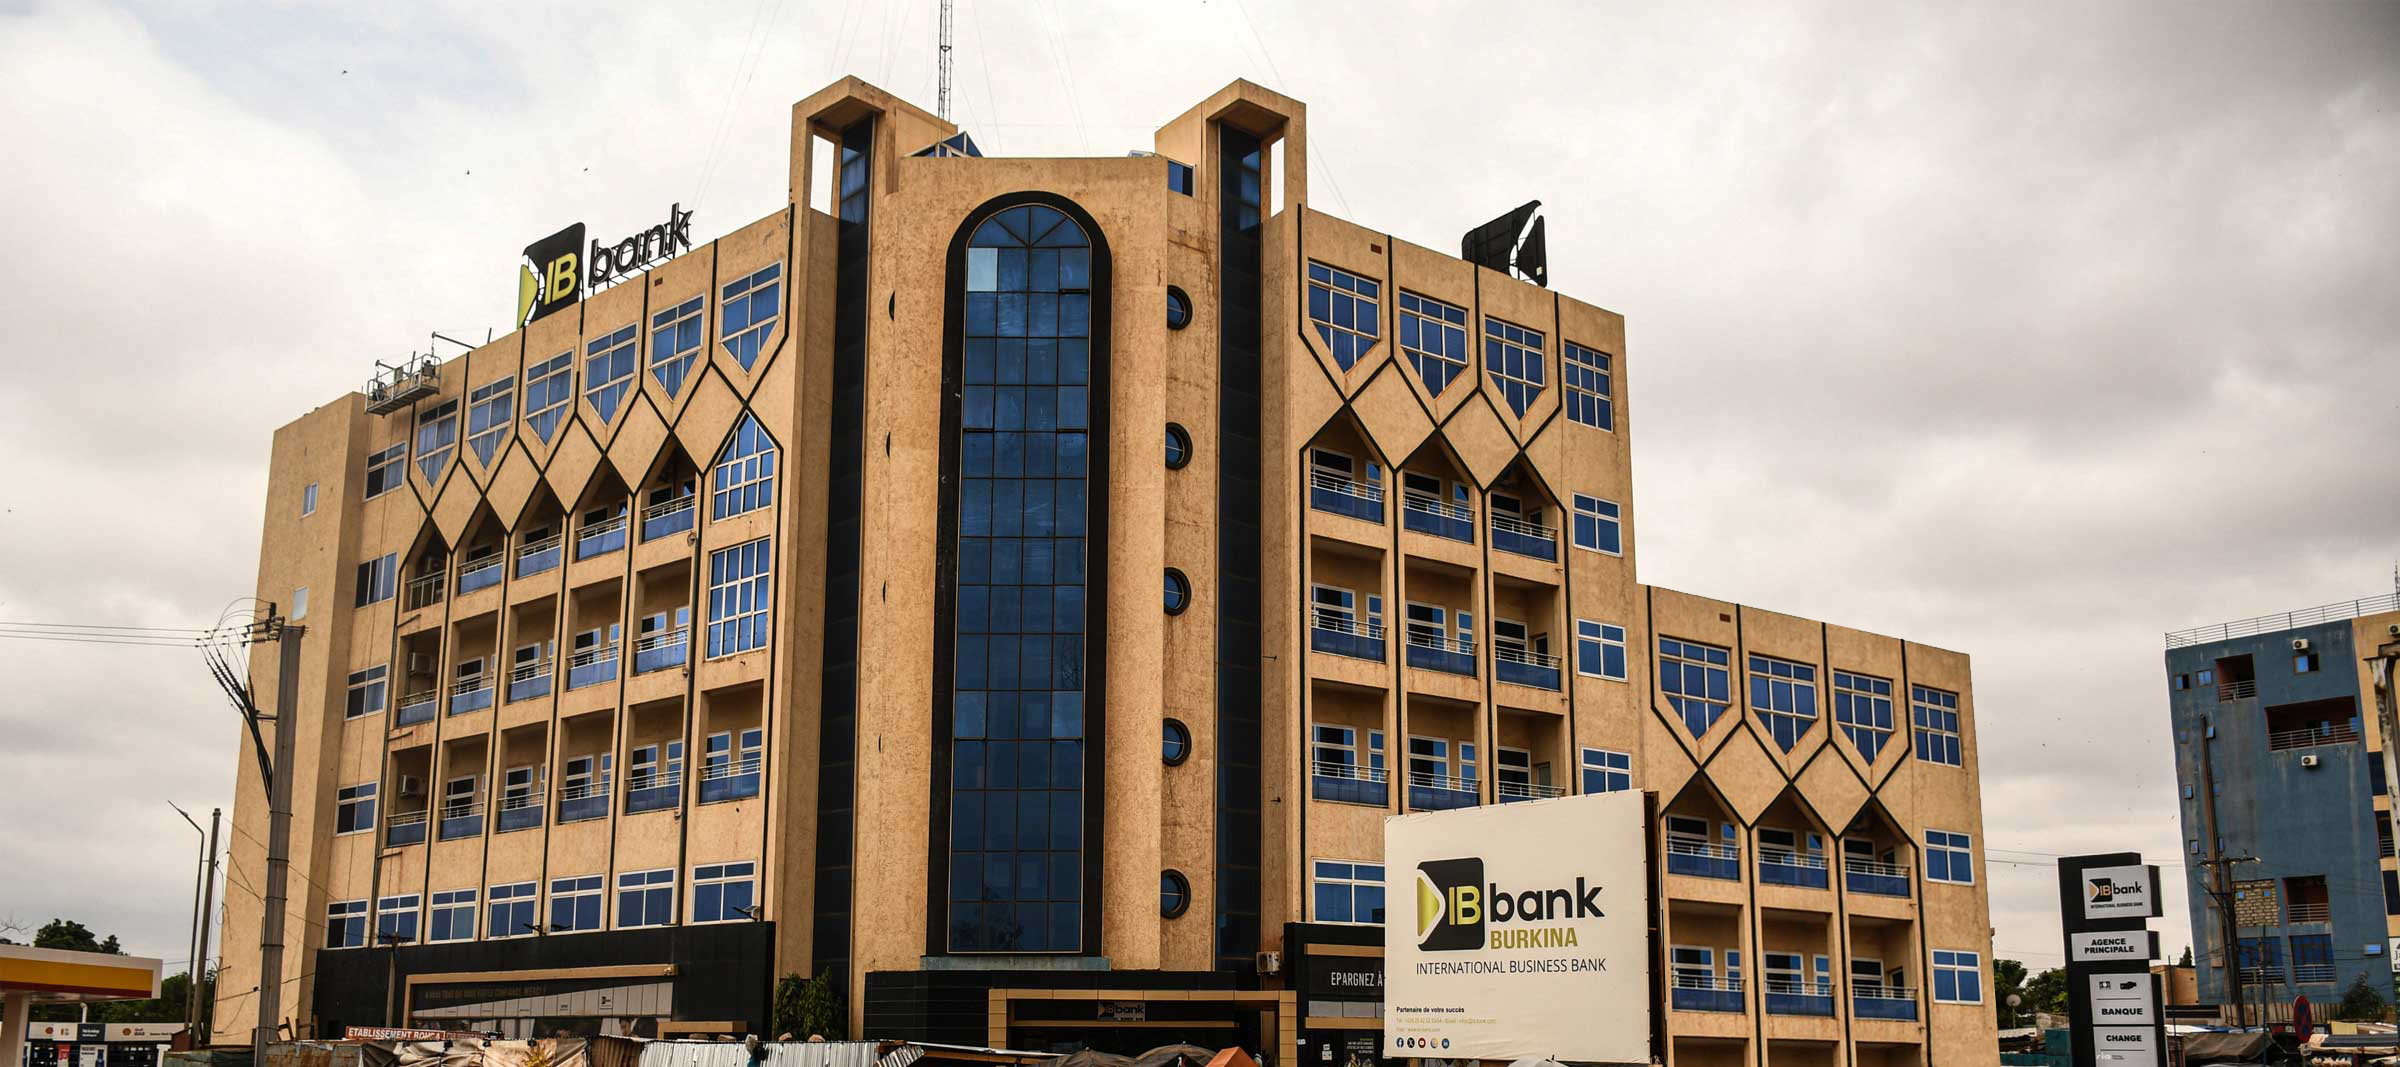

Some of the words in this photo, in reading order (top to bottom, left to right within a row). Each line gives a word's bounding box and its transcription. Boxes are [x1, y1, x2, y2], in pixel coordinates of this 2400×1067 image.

[588, 202, 694, 288] bank
[2113, 881, 2143, 895] bank
[1489, 876, 1605, 923] bank
[1490, 927, 1578, 950] BURKINA
[2091, 938, 2127, 946] AGENCE
[2084, 945, 2135, 954] PRINCIPALE
[1416, 961, 1506, 976] INTERNATIONAL
[1509, 959, 1568, 974] BUSINESS
[1571, 958, 1607, 972] BANK
[1331, 971, 1375, 987] EPARGNEZ
[2101, 1007, 2143, 1016] BANQUE
[348, 1027, 412, 1041] ETABLISSEMENT
